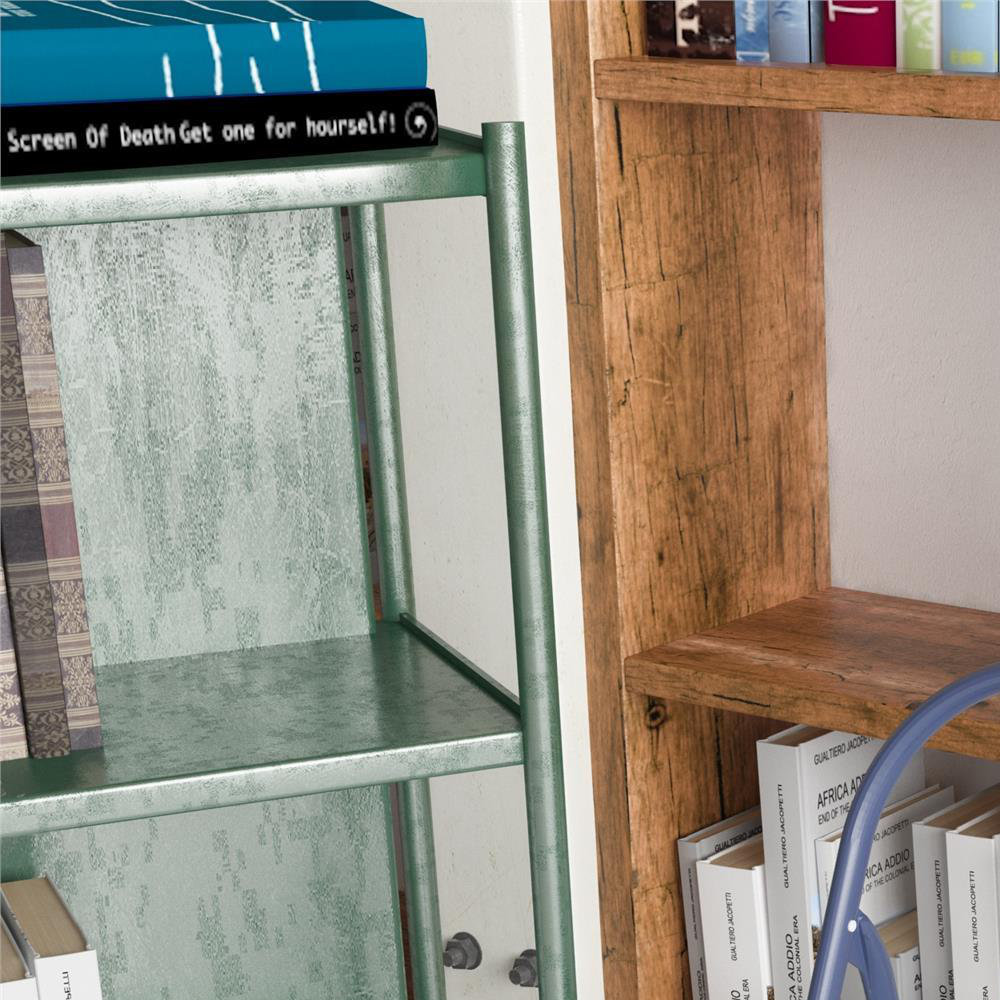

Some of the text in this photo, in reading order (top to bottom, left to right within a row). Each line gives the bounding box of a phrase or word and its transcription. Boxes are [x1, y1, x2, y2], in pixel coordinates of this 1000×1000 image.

[8, 124, 175, 152] Screen Of Death
[179, 121, 212, 143] Get
[222, 124, 255, 141] one
[265, 116, 296, 138] for
[817, 782, 849, 809] AFRICA
[777, 783, 789, 888] GUALTIERO JACOPETTI
[934, 859, 942, 901] JACOPETTI
[785, 933, 796, 981] ADDIO
